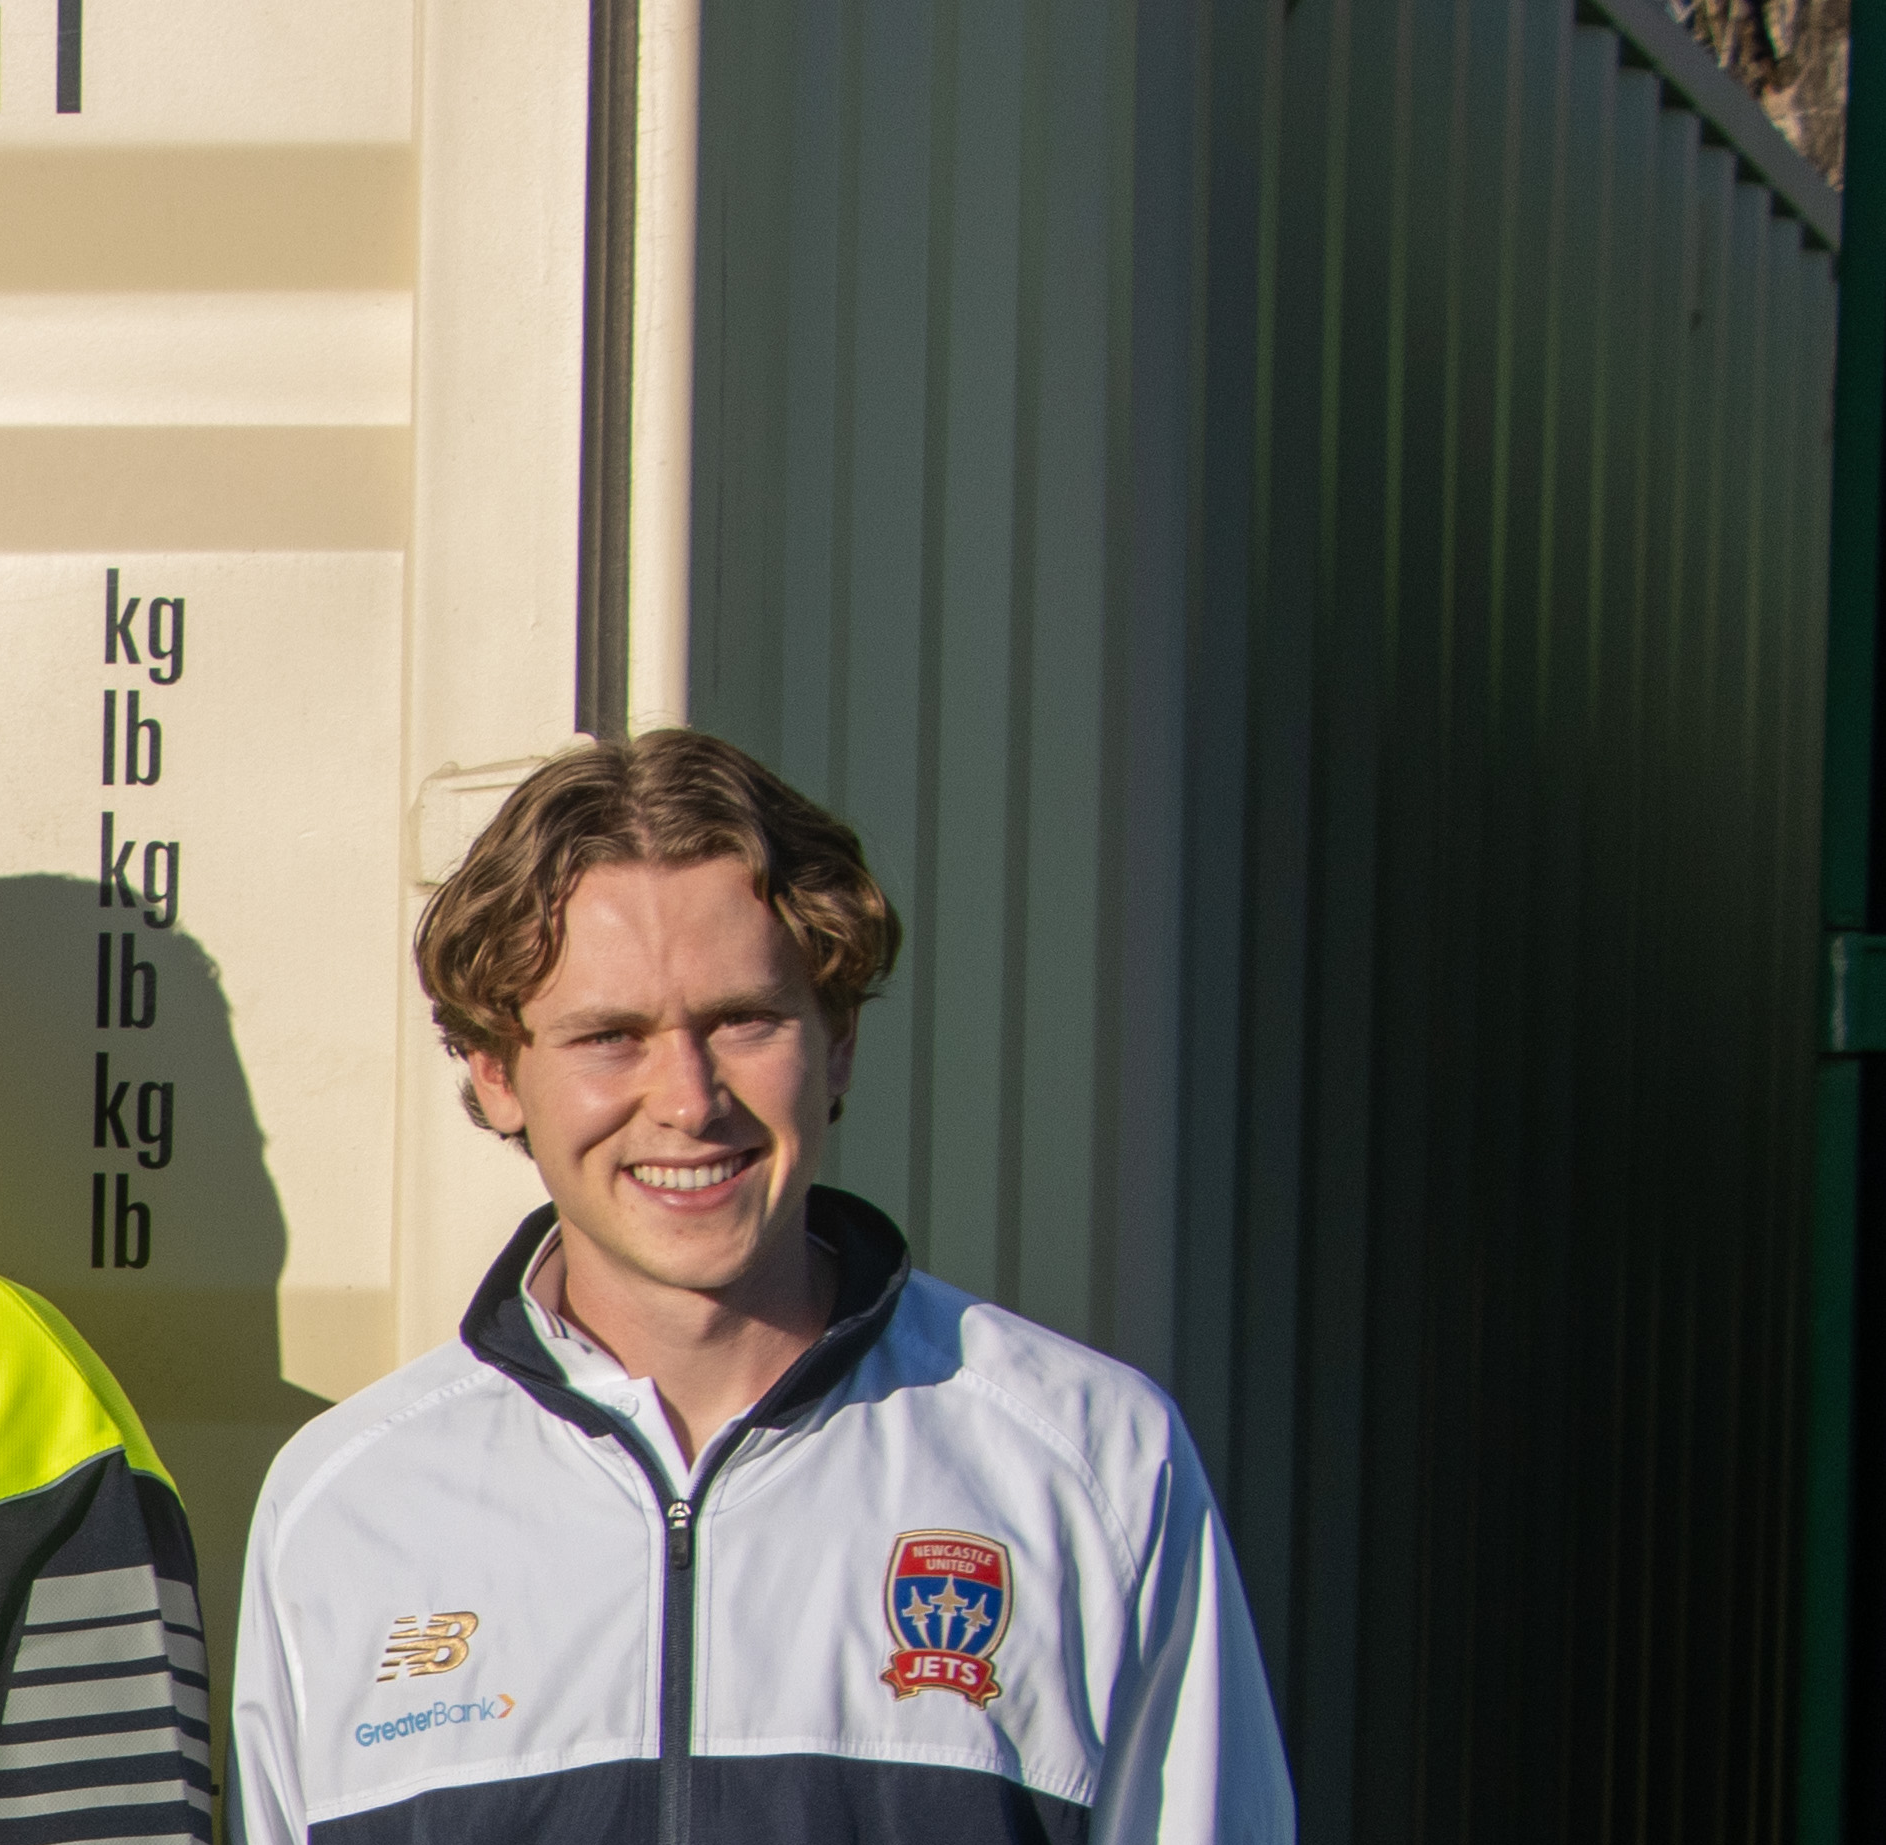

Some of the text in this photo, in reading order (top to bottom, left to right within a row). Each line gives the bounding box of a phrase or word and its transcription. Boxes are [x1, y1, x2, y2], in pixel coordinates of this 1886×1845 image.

[103, 568, 186, 686] kg
[101, 688, 162, 786] lb
[98, 813, 180, 929] kg
[95, 931, 161, 1029] lb
[92, 1051, 175, 1170] kg
[90, 1171, 152, 1270] lb
[913, 1545, 994, 1567] NEWCASTLE
[926, 1558, 977, 1574] UNITED
[905, 1655, 979, 1686] JETS
[355, 1697, 496, 1748] GreaterBank
